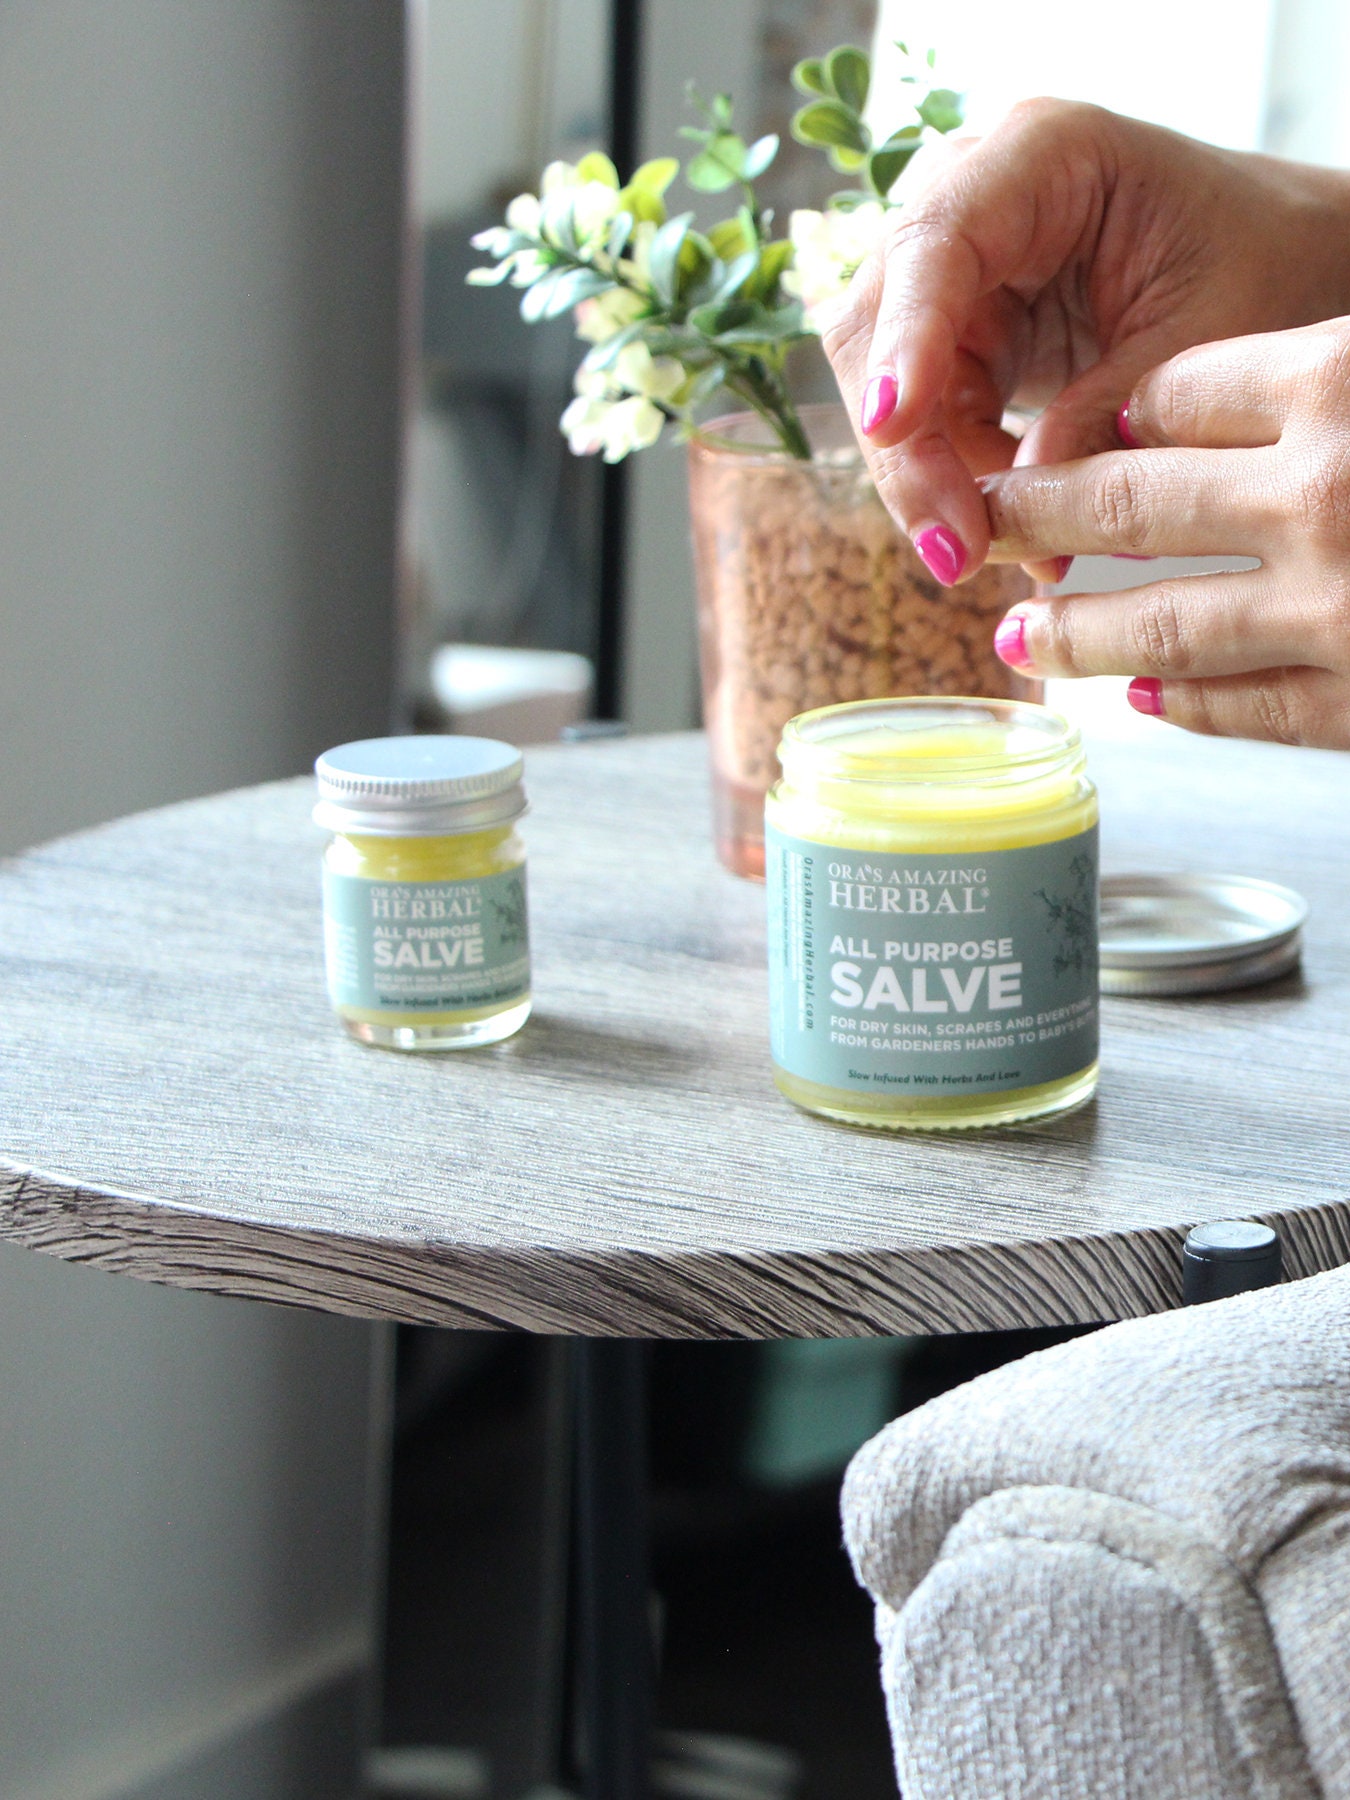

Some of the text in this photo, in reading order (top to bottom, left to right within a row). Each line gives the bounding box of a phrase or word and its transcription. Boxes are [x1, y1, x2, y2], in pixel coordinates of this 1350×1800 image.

[828, 862, 987, 885] ORA'S AMAZING
[414, 884, 480, 899] AMAZING
[373, 923, 481, 939] ALL PURPOSE
[373, 938, 485, 968] SALVE
[804, 857, 815, 1029] OrasAmazingHerbal.com
[829, 935, 1013, 962] ALL PURPOSE
[830, 961, 1022, 1013] SALVE
[830, 1015, 856, 1031] FOR
[860, 1019, 888, 1034] DRY
[893, 1023, 931, 1037] SKIN,
[936, 1020, 1002, 1035] SCRAPES
[1006, 1015, 1033, 1030] AND
[830, 1031, 867, 1048] FROM
[871, 1037, 961, 1051] GARDENERS
[965, 1034, 1015, 1050] HANDS
[1020, 1031, 1036, 1044] TO
[848, 1069, 1020, 1085] Slow Infused With Herbs And Love
